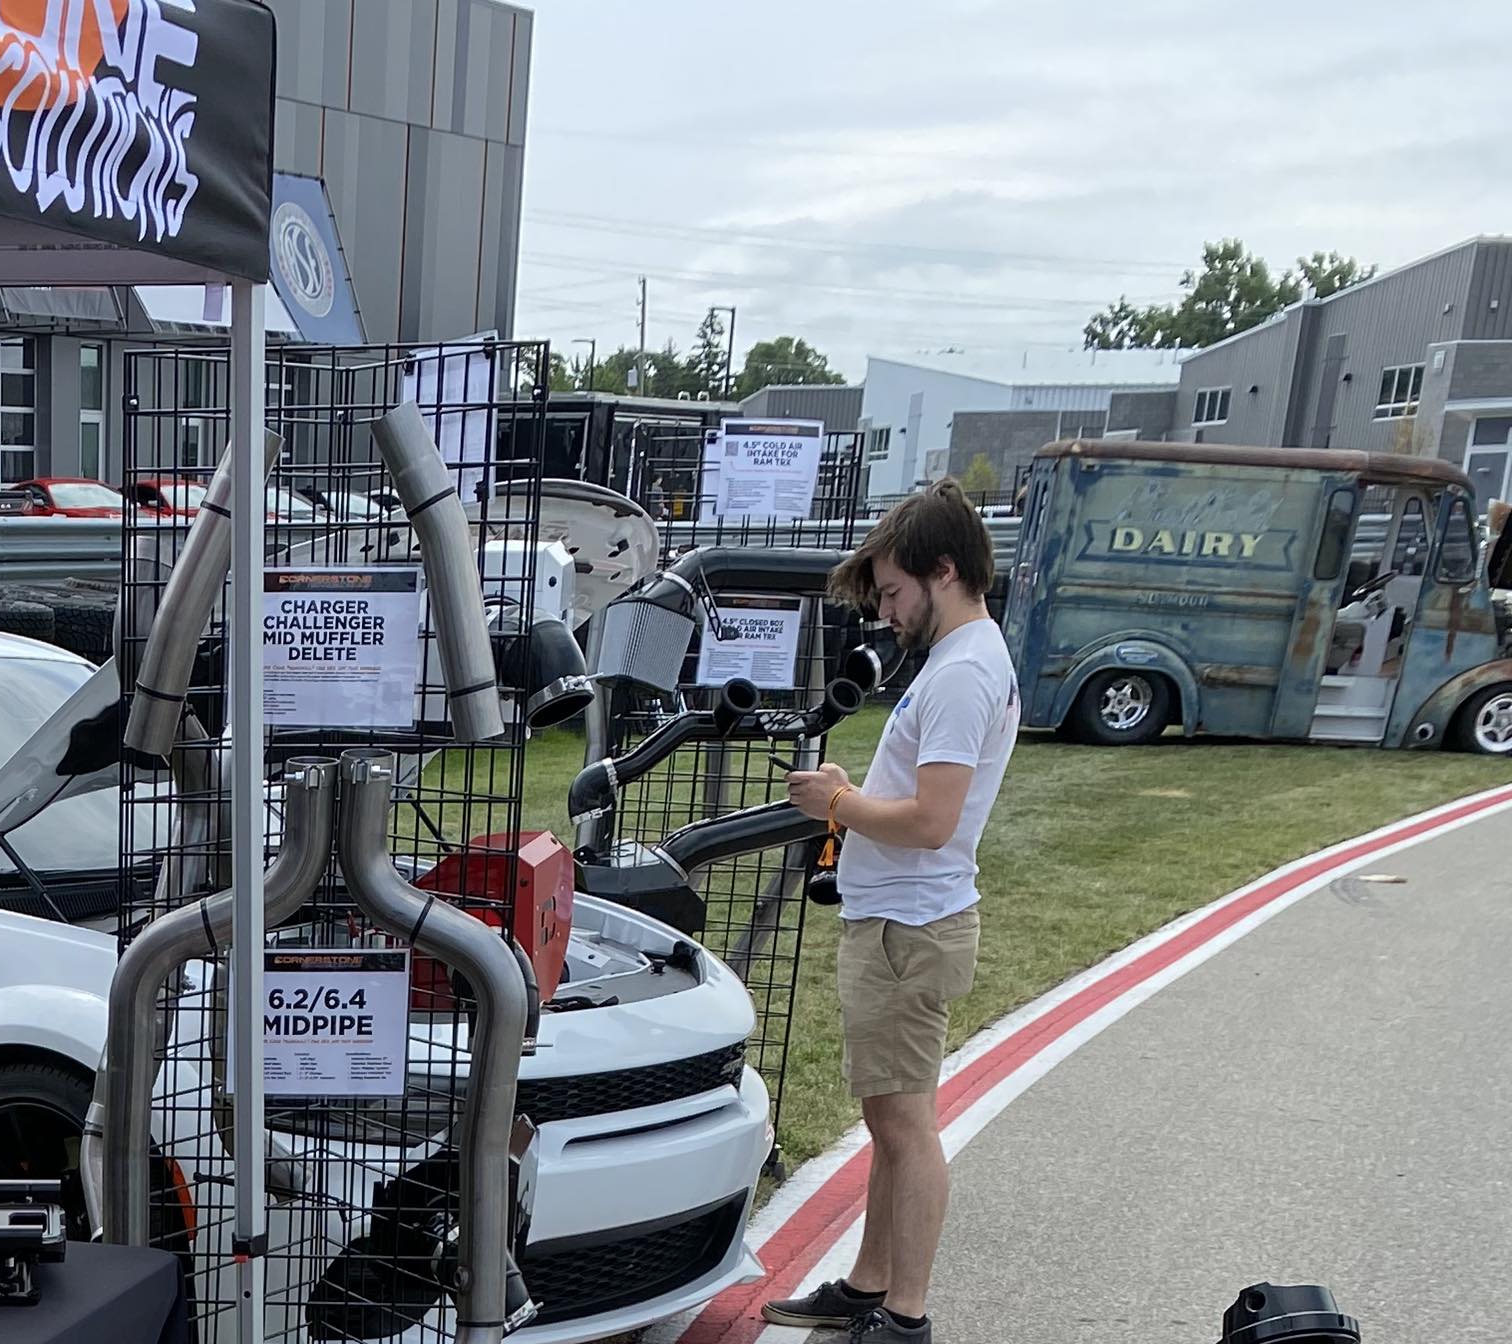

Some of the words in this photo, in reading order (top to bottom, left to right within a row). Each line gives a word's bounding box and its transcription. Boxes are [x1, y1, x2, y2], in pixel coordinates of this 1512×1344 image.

[762, 441, 787, 450] COLD
[788, 442, 803, 450] AIR
[747, 449, 778, 457] INTAKE
[781, 450, 799, 458] FOR
[753, 458, 773, 466] RAM
[1110, 525, 1265, 559] DAIRY
[281, 600, 369, 614] CHARGER
[263, 615, 385, 630] CHALLENGER
[263, 631, 295, 645] MID
[300, 631, 384, 645] MUFFLER
[744, 632, 761, 640] RAM
[288, 646, 357, 661] DELETE
[268, 985, 367, 1013] 6.2/6.4
[263, 1015, 373, 1036] MIDPIPE
